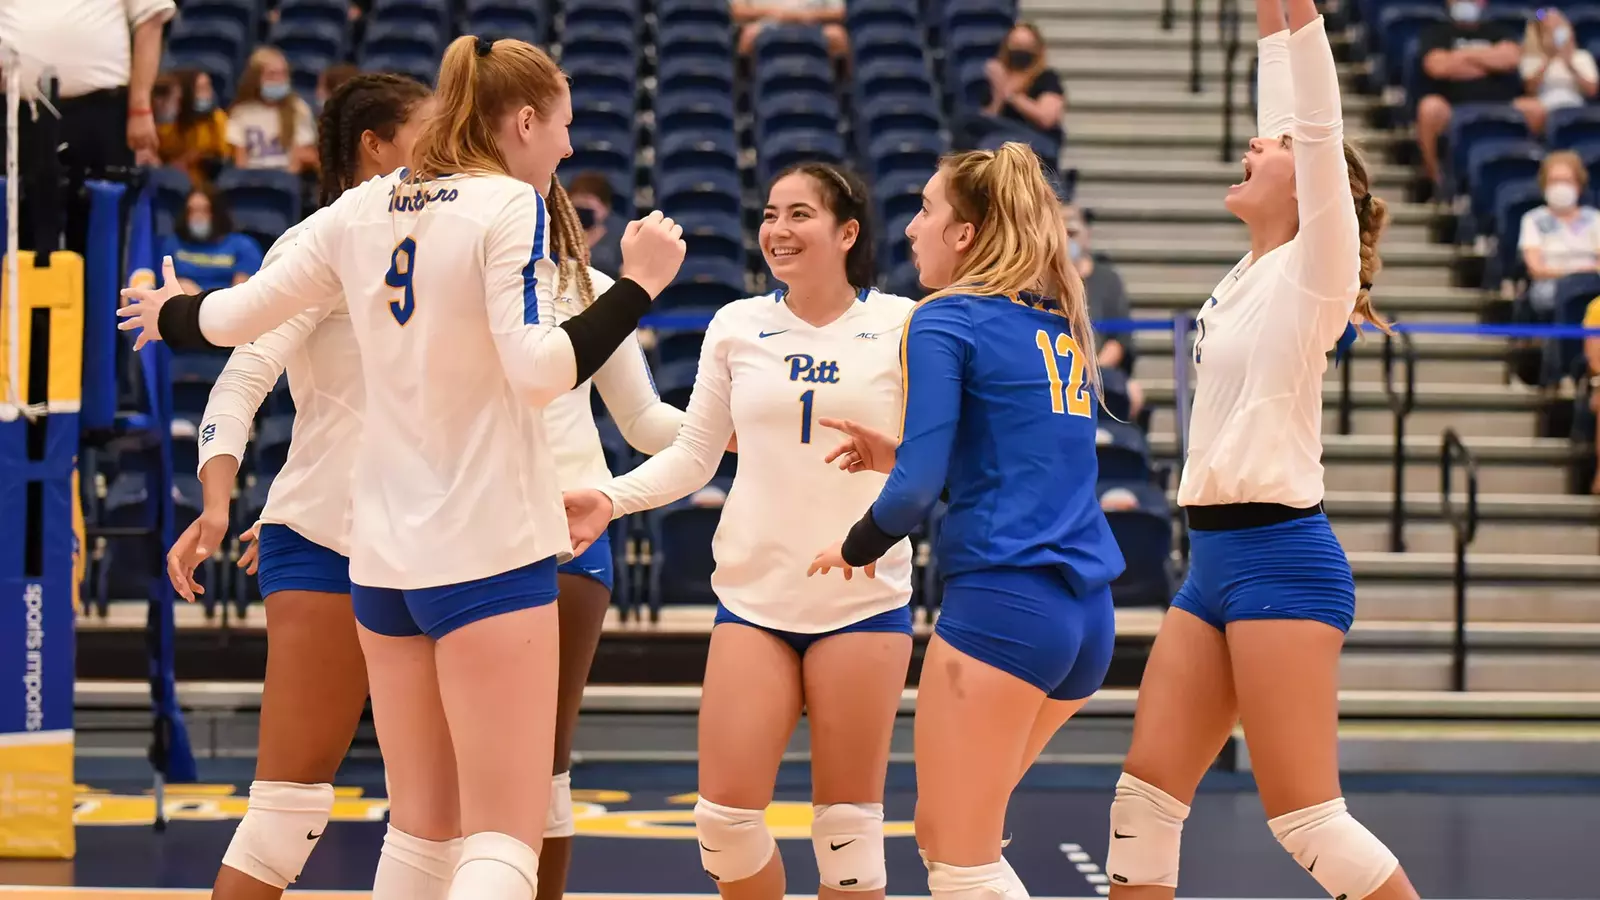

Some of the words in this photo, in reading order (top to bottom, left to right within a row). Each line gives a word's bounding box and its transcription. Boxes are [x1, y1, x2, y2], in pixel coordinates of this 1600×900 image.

[384, 235, 417, 328] 9
[784, 353, 840, 384] Pitt
[855, 332, 878, 340] ACC
[1036, 329, 1091, 418] 12
[799, 389, 815, 444] 1
[23, 583, 45, 650] sports
[22, 651, 44, 732] imports
